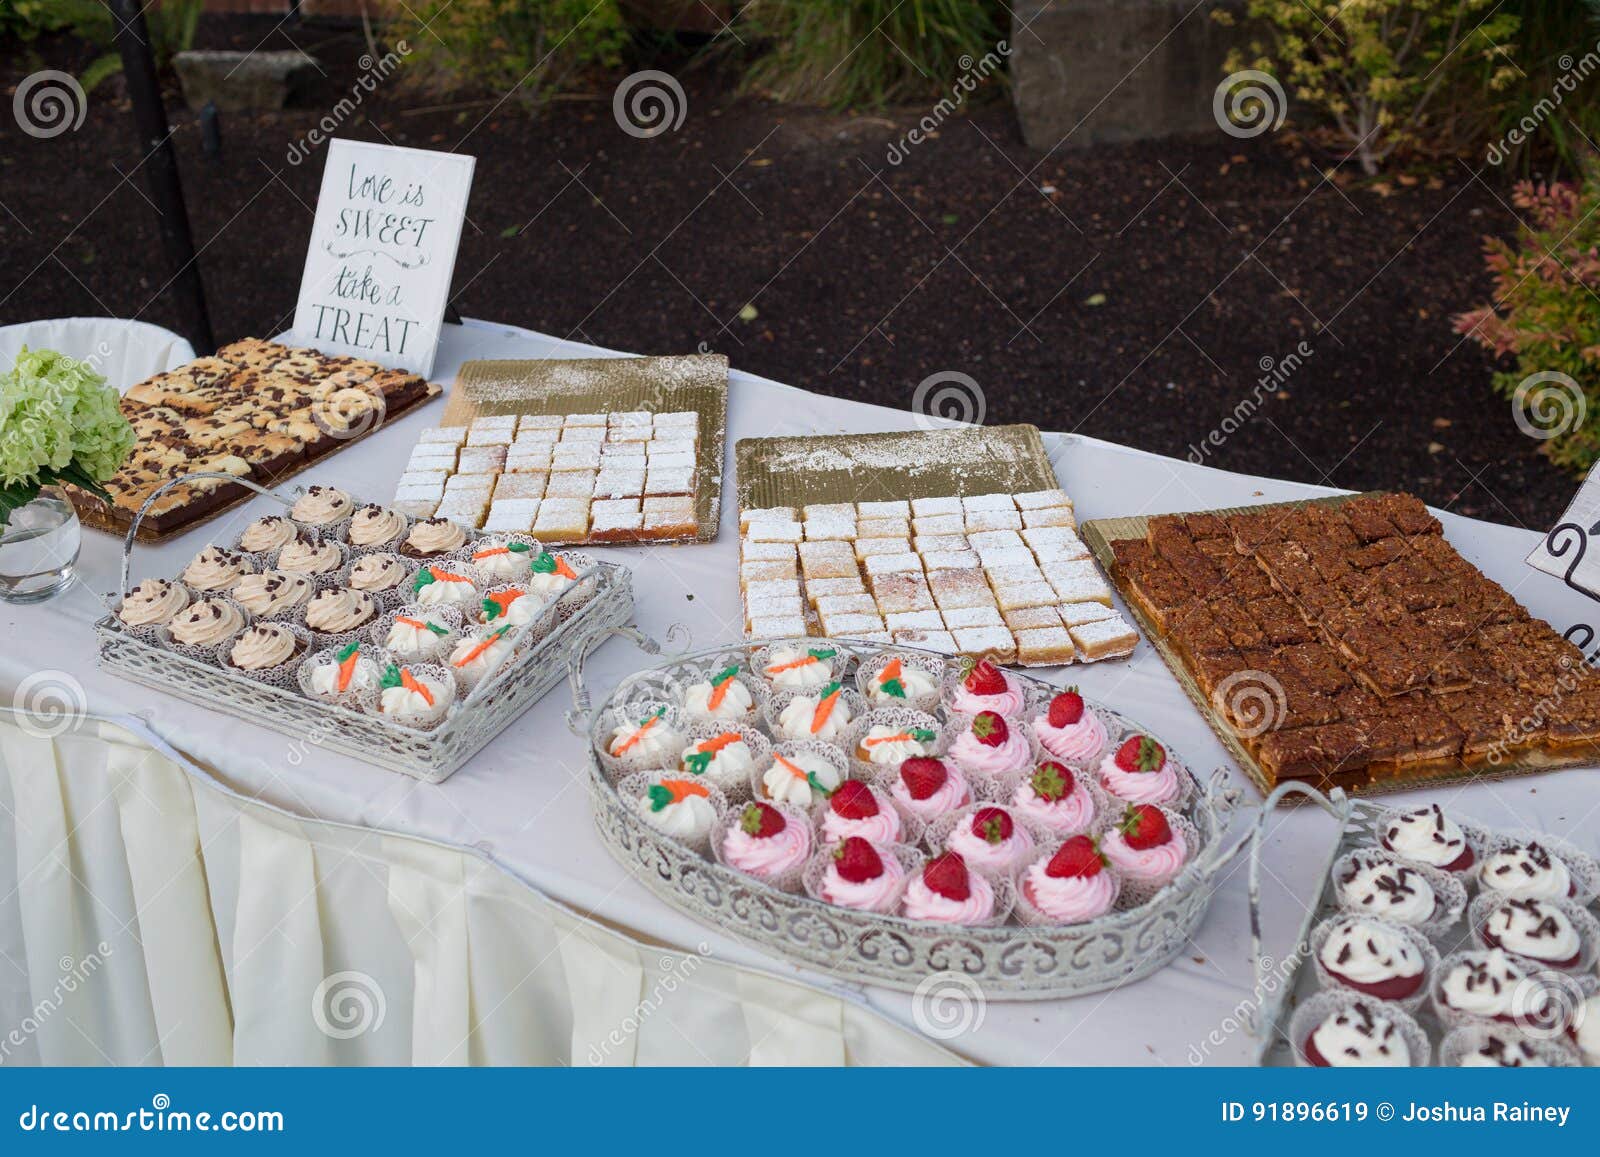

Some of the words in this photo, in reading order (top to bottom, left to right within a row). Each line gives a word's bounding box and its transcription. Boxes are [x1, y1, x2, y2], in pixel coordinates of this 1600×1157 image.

[398, 183, 424, 207] is
[335, 207, 434, 248] SWEET
[328, 265, 381, 305] take
[386, 285, 402, 306] a
[312, 303, 420, 354] TREAT
